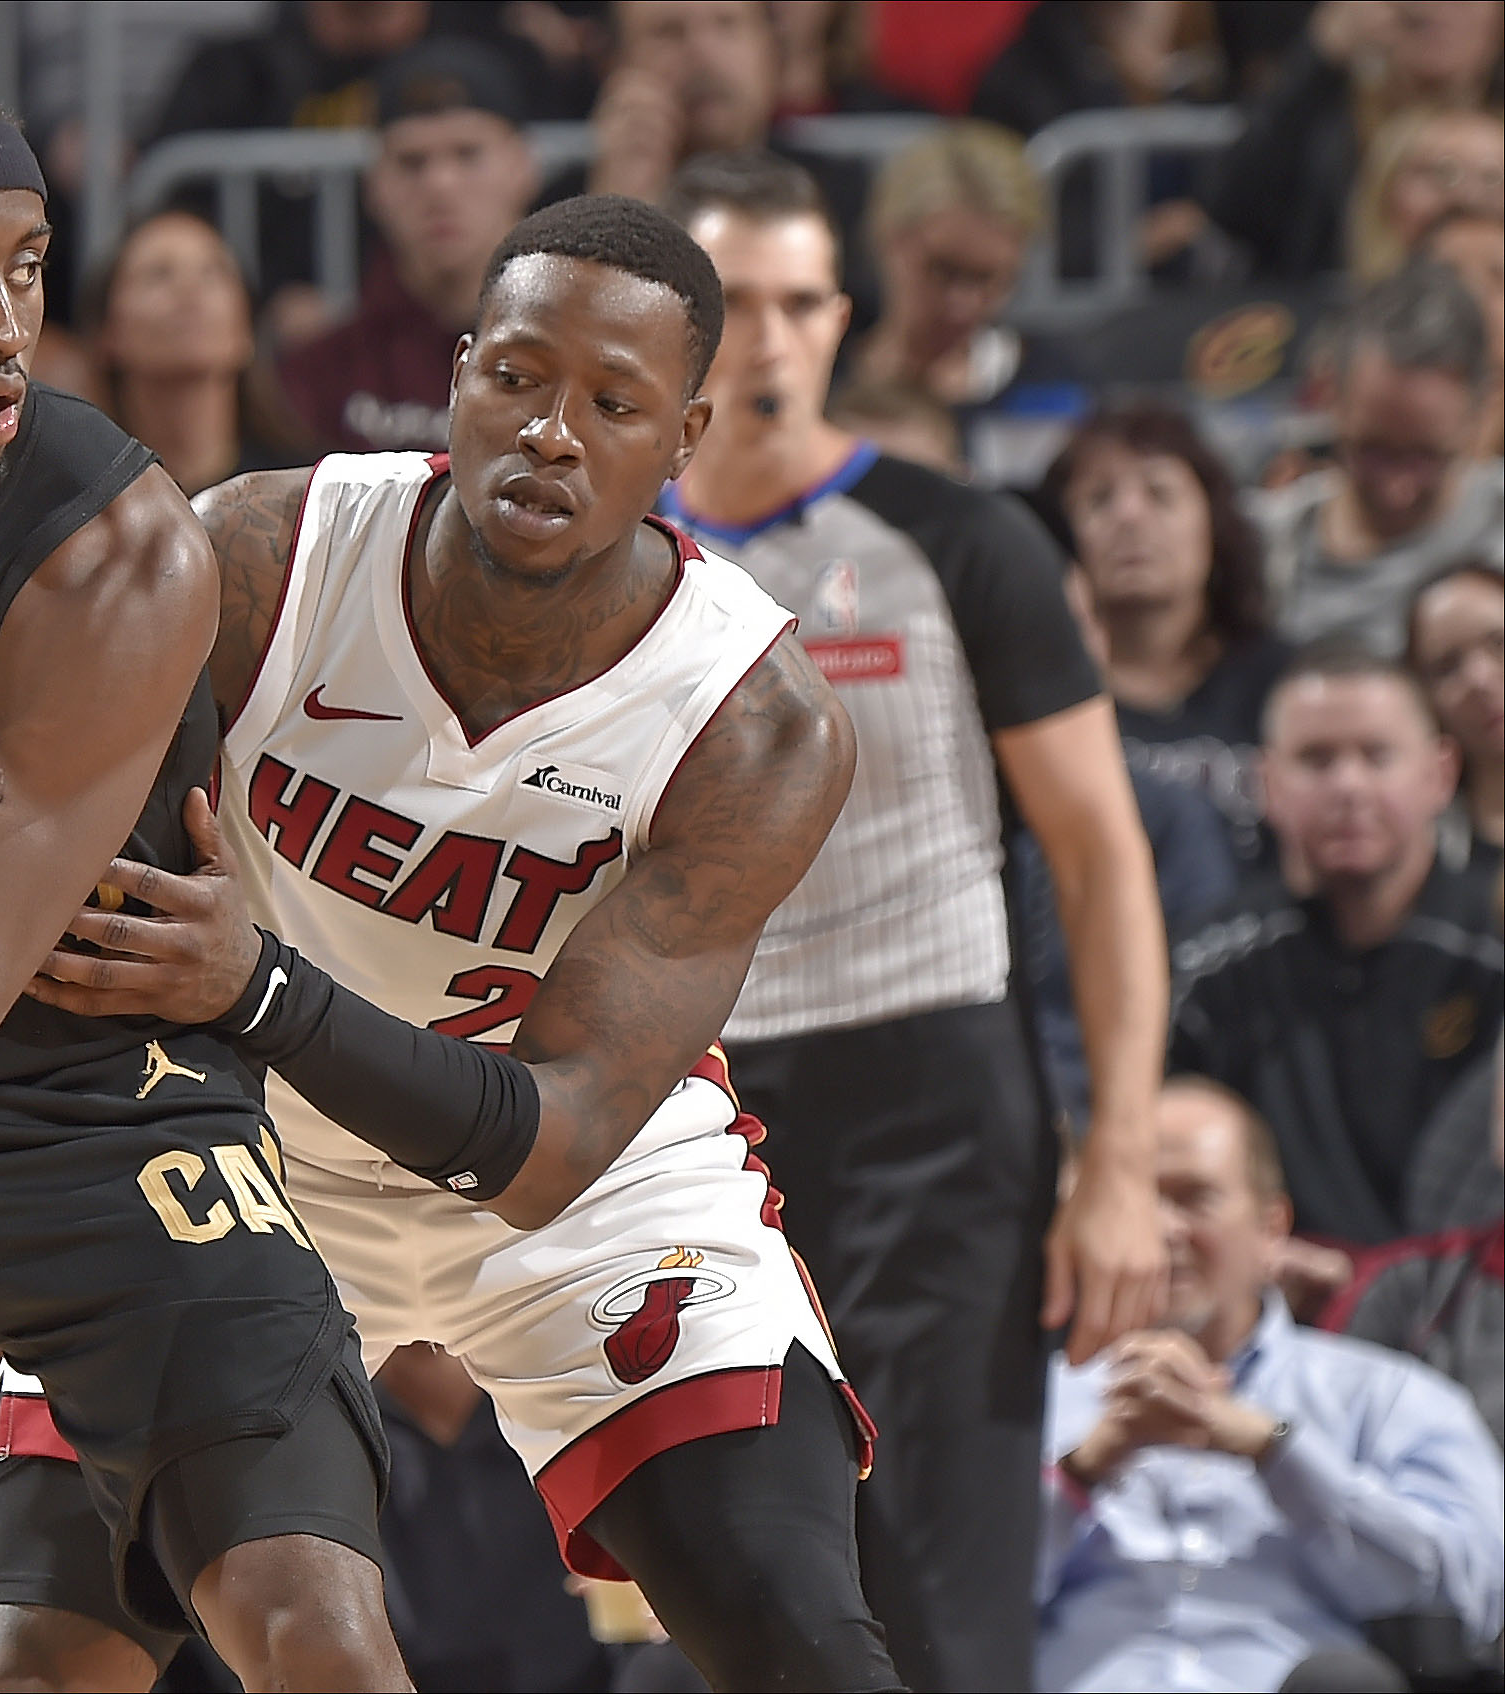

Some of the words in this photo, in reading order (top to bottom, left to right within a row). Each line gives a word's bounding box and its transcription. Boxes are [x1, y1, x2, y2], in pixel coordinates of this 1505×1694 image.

[546, 776, 622, 811] Carnival
[248, 752, 624, 955] HEAT
[428, 964, 544, 1055] 2
